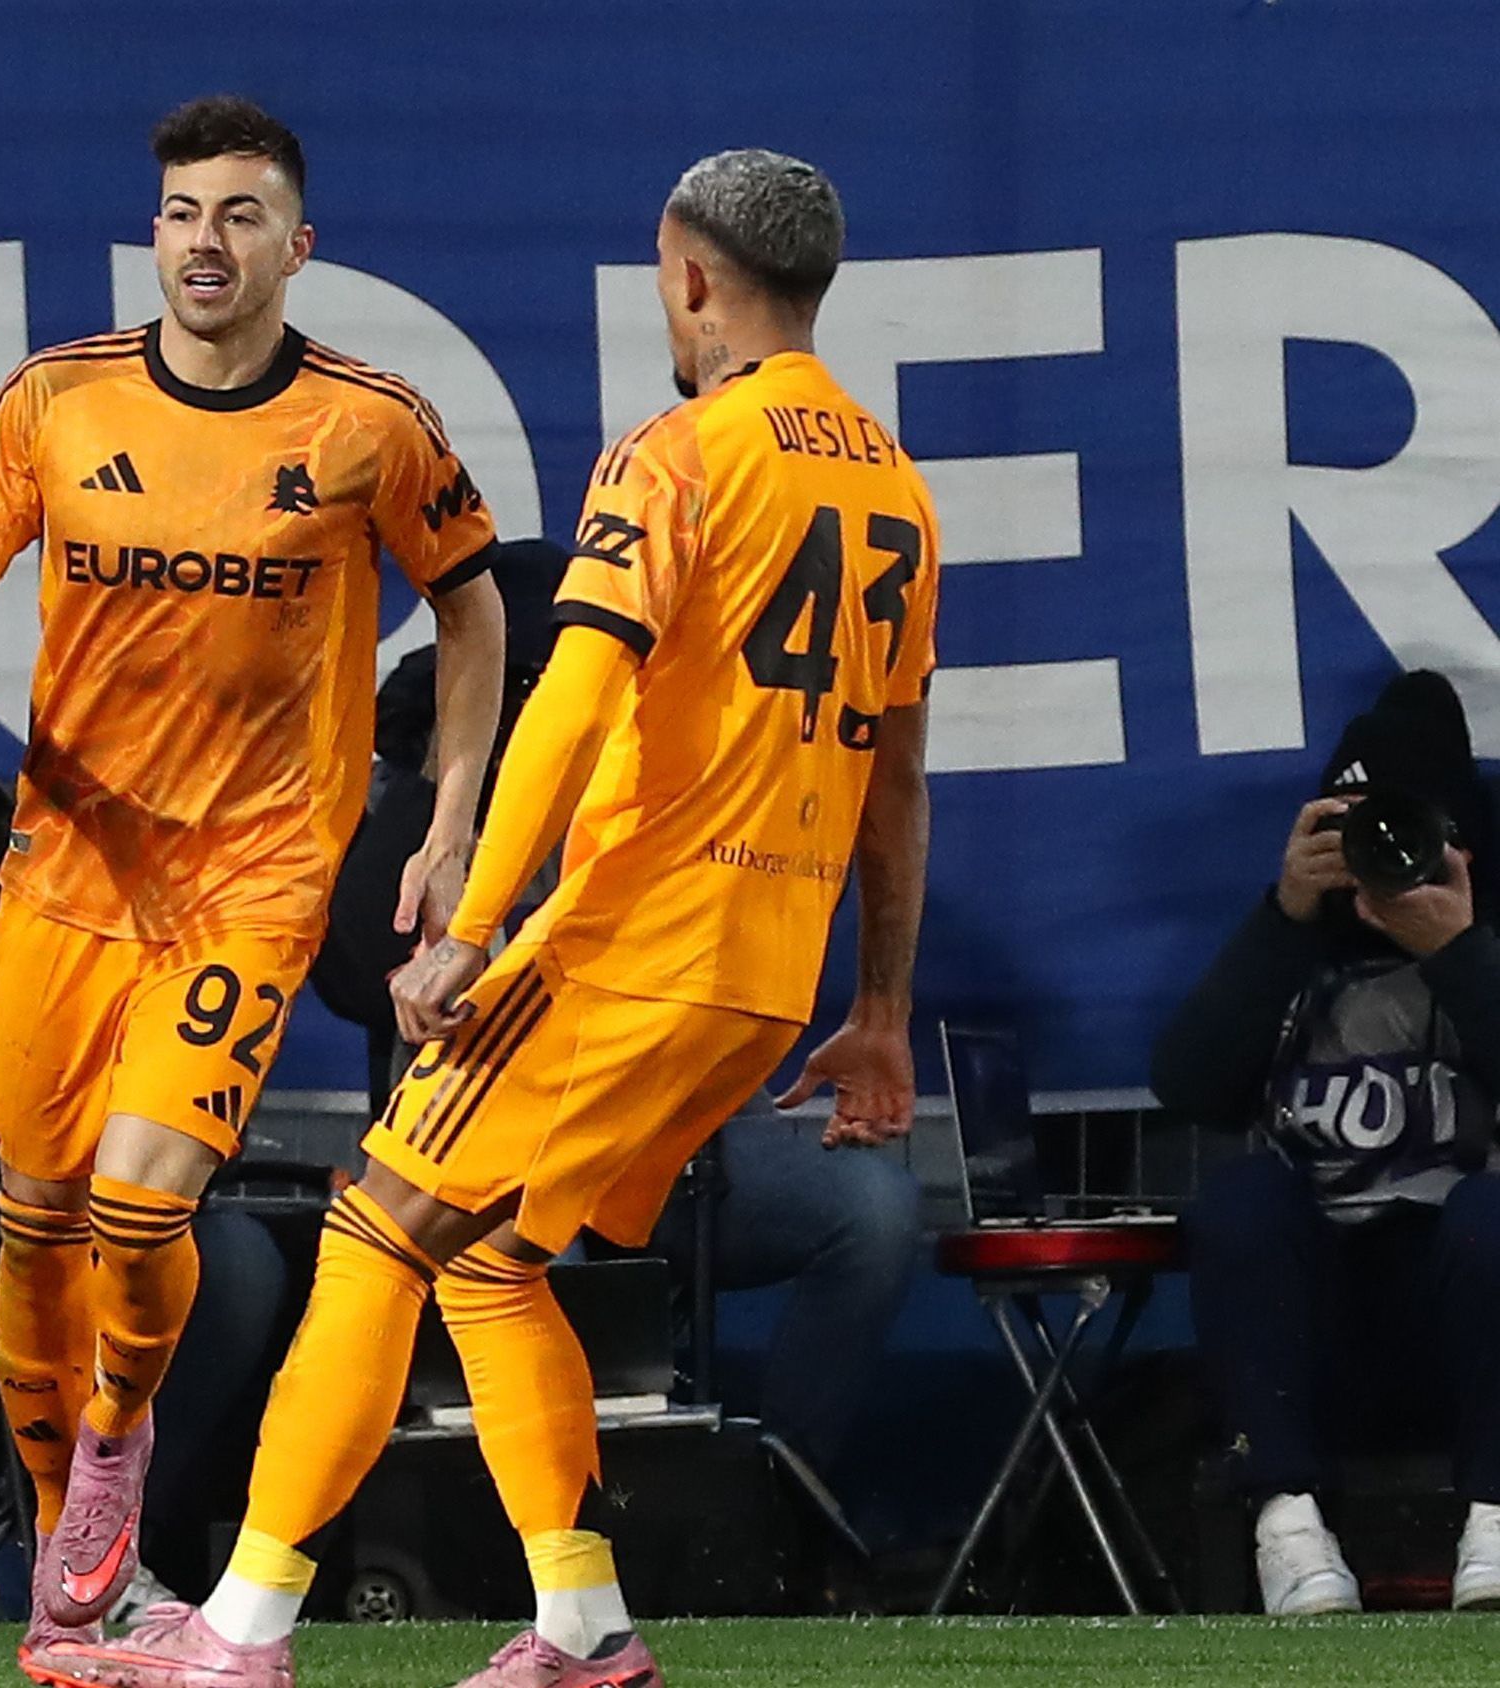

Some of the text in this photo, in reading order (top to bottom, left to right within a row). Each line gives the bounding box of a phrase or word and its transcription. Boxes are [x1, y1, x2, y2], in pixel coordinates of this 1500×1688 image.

[763, 406, 898, 468] WESLEY
[64, 540, 323, 598] EUROBET
[740, 504, 922, 752] 43
[176, 963, 284, 1079] 92
